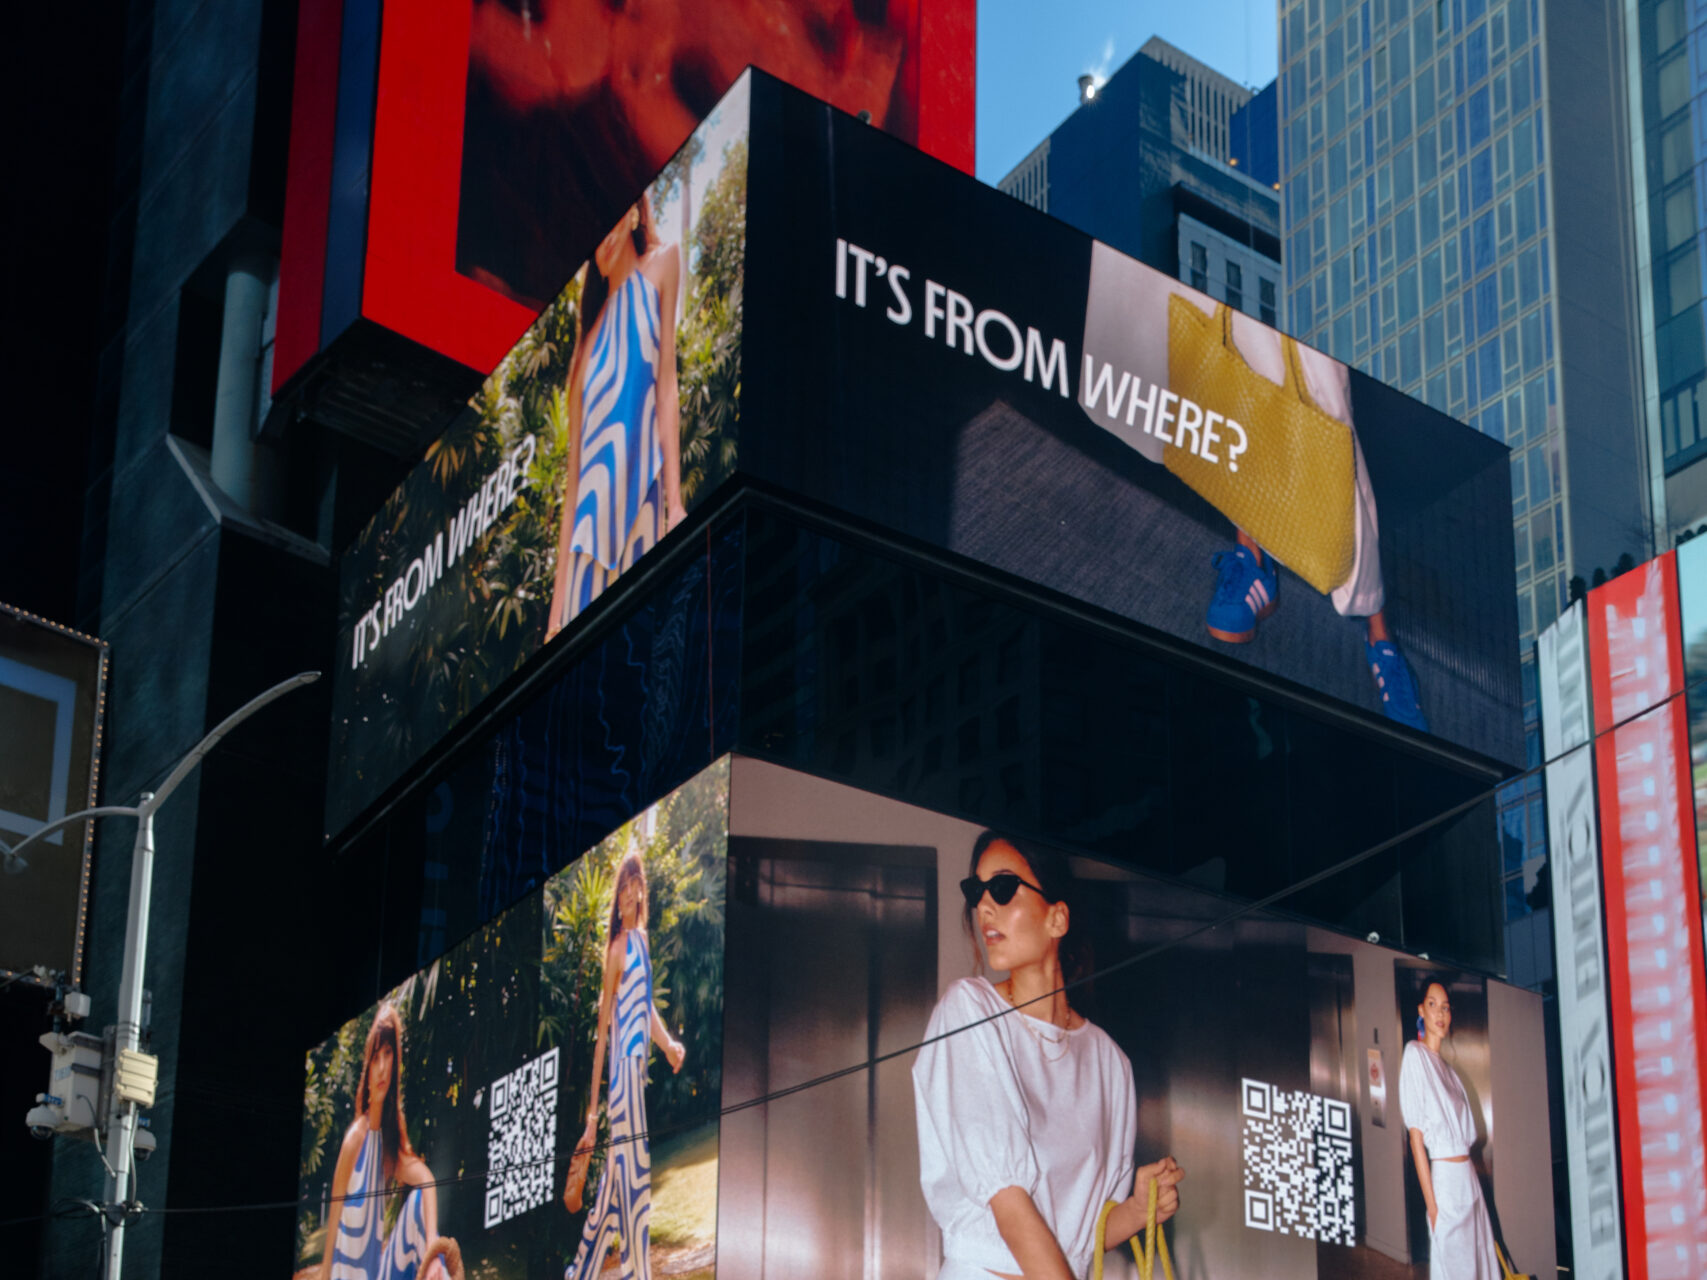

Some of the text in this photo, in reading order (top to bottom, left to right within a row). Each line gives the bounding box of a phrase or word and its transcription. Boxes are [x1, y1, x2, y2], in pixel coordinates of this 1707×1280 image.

[835, 238, 1249, 473] IT'S FROM WHERE?
[351, 433, 537, 670] IT'S FROM WHERE?
